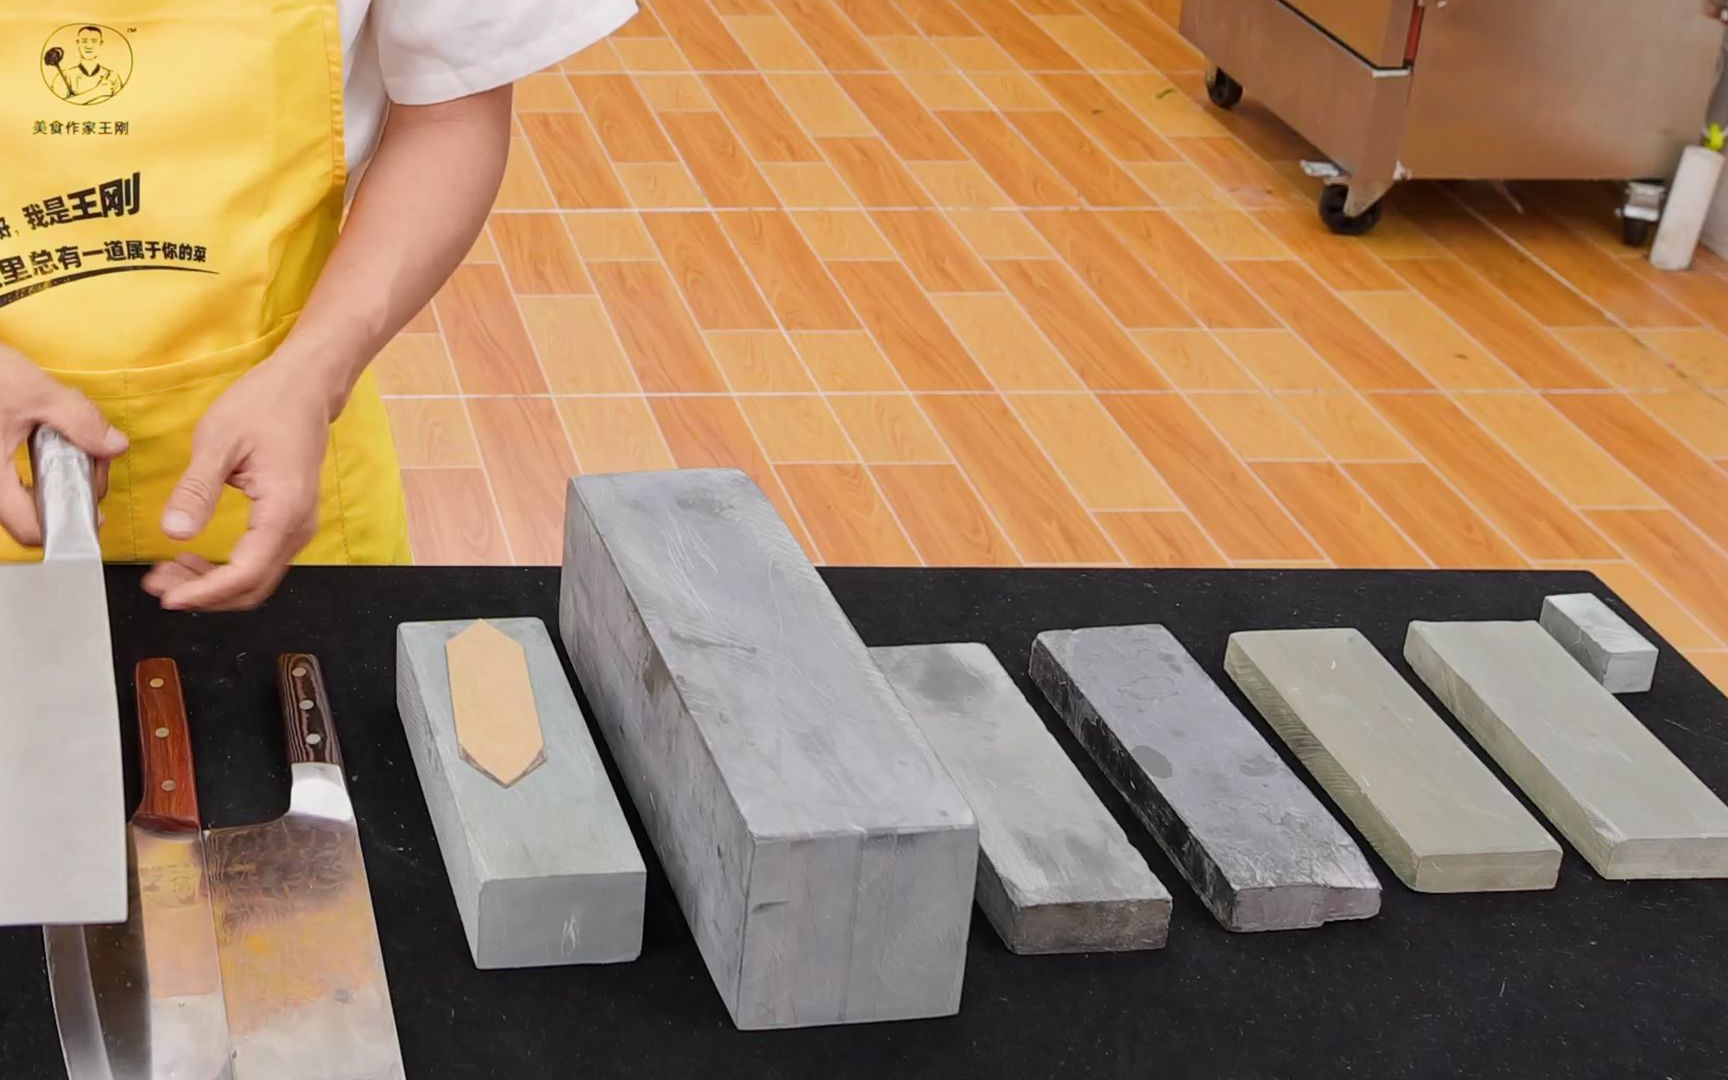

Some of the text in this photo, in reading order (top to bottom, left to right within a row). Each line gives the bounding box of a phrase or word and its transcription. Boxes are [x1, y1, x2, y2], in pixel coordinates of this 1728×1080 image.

[33, 120, 129, 136] 美食作家王刚
